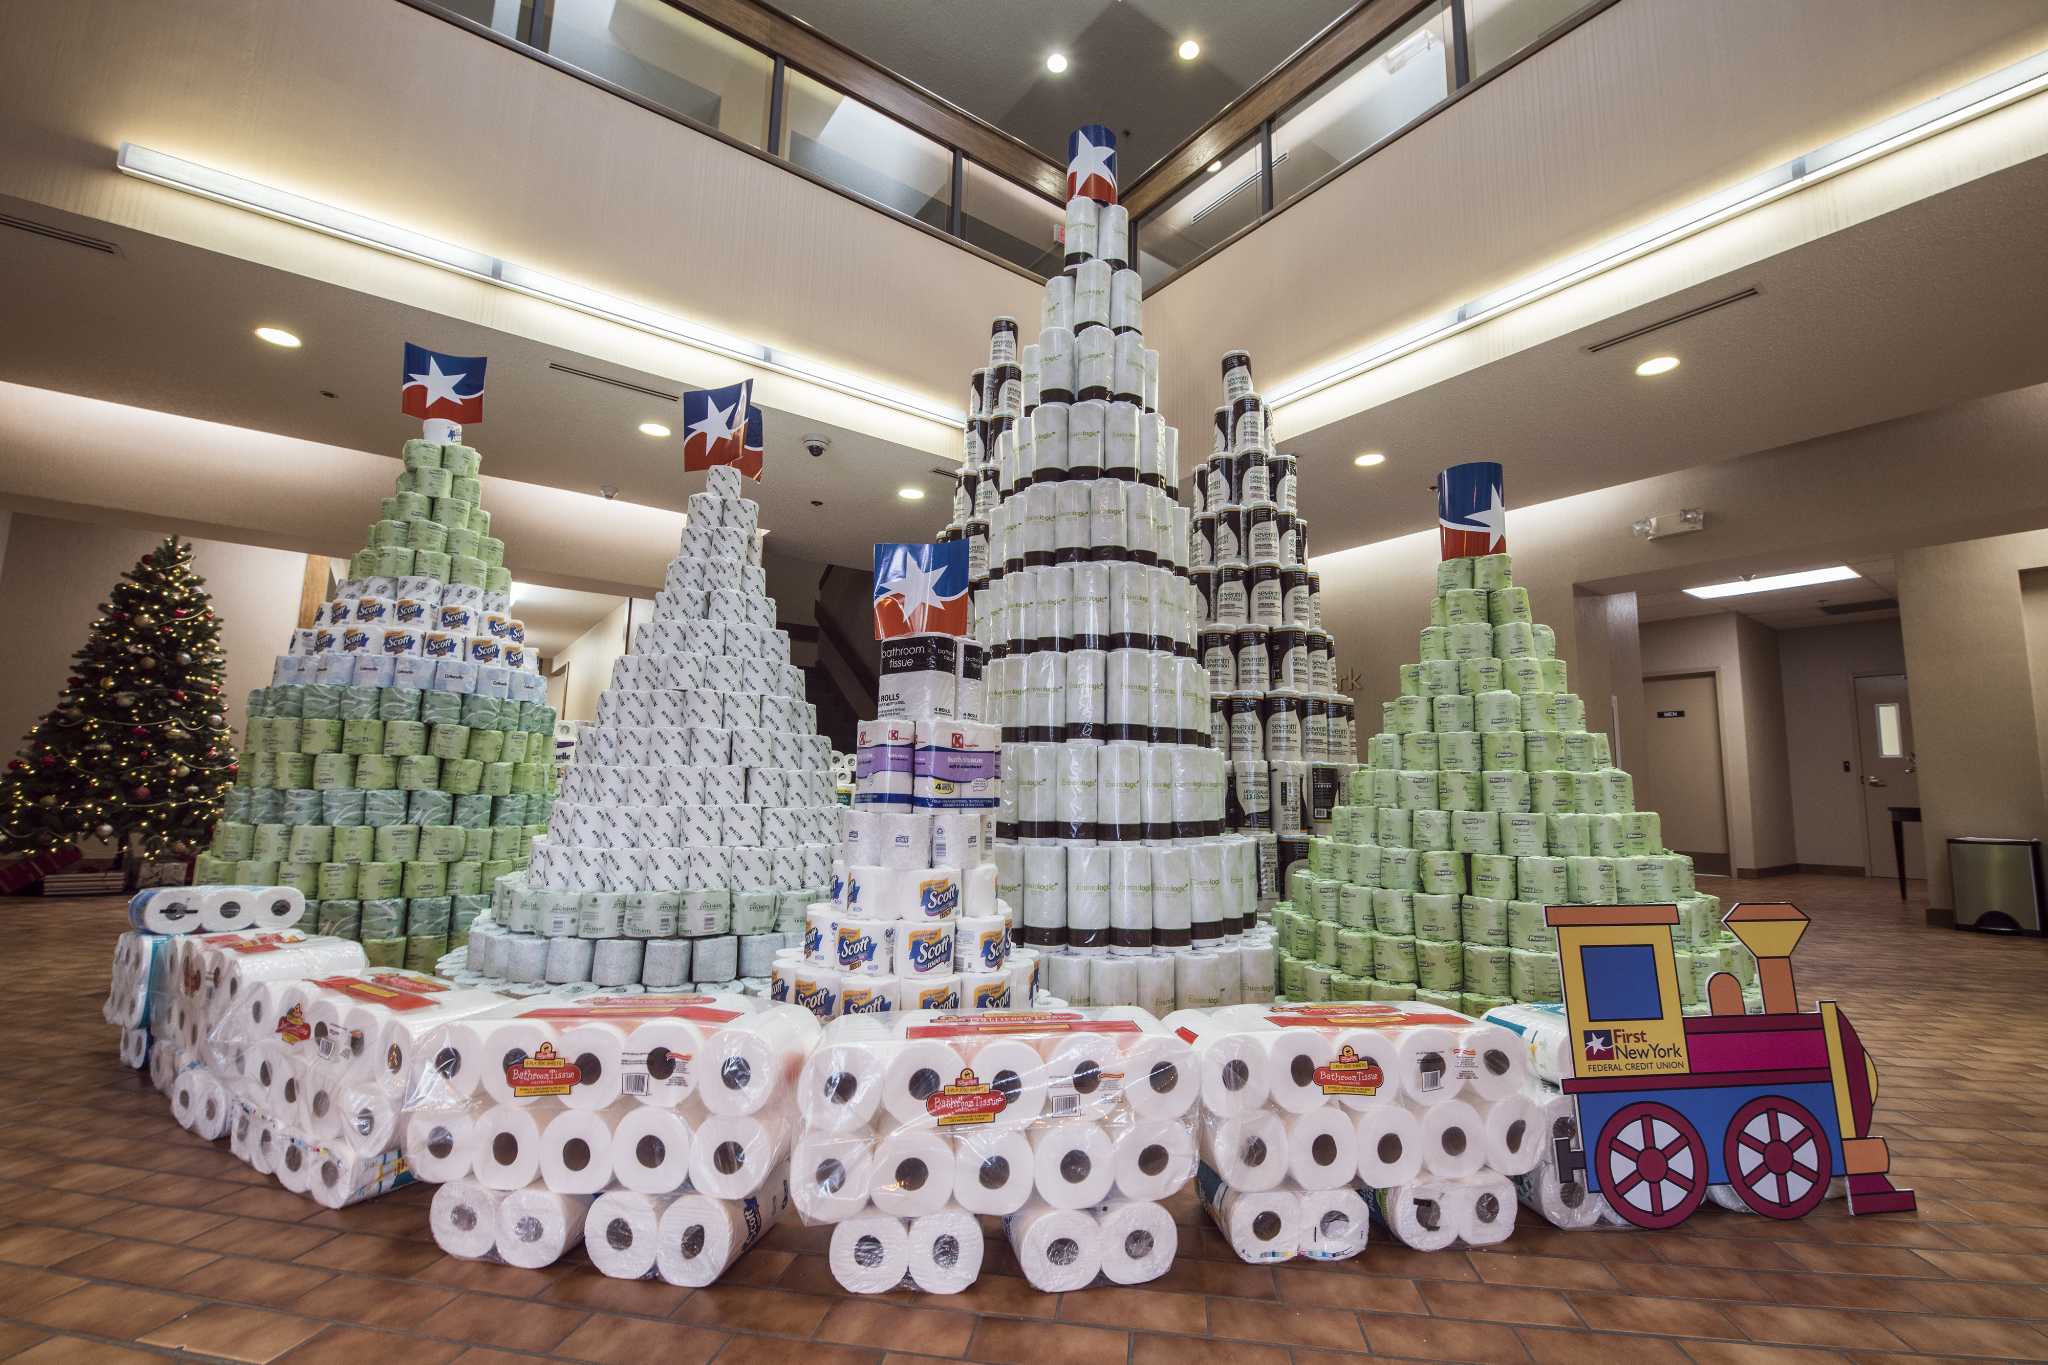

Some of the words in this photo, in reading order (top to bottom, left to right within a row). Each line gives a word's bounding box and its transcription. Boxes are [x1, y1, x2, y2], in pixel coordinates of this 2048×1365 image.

[443, 611, 467, 623] Scott
[387, 635, 411, 648] Scott
[428, 638, 453, 651] Scott
[476, 644, 498, 656] Scott
[889, 659, 914, 669] tissue
[1338, 667, 1362, 691] rk
[1271, 722, 1297, 730] seventh
[928, 883, 956, 909] Scott
[841, 935, 873, 958] Scott
[918, 934, 951, 964] Scott
[798, 987, 828, 1008] Scott
[850, 994, 884, 1014] Scott
[1613, 1028, 1648, 1043] First
[1588, 1063, 1623, 1072] FEDERAL
[1624, 1062, 1654, 1071] CREDIT
[1656, 1061, 1685, 1070] UNION
[512, 1068, 549, 1081] Bathroom
[549, 1068, 576, 1080] Tissue
[1319, 1070, 1357, 1082] Bathroom
[934, 1095, 975, 1109] Bathroom
[974, 1095, 1004, 1108] Tissue
